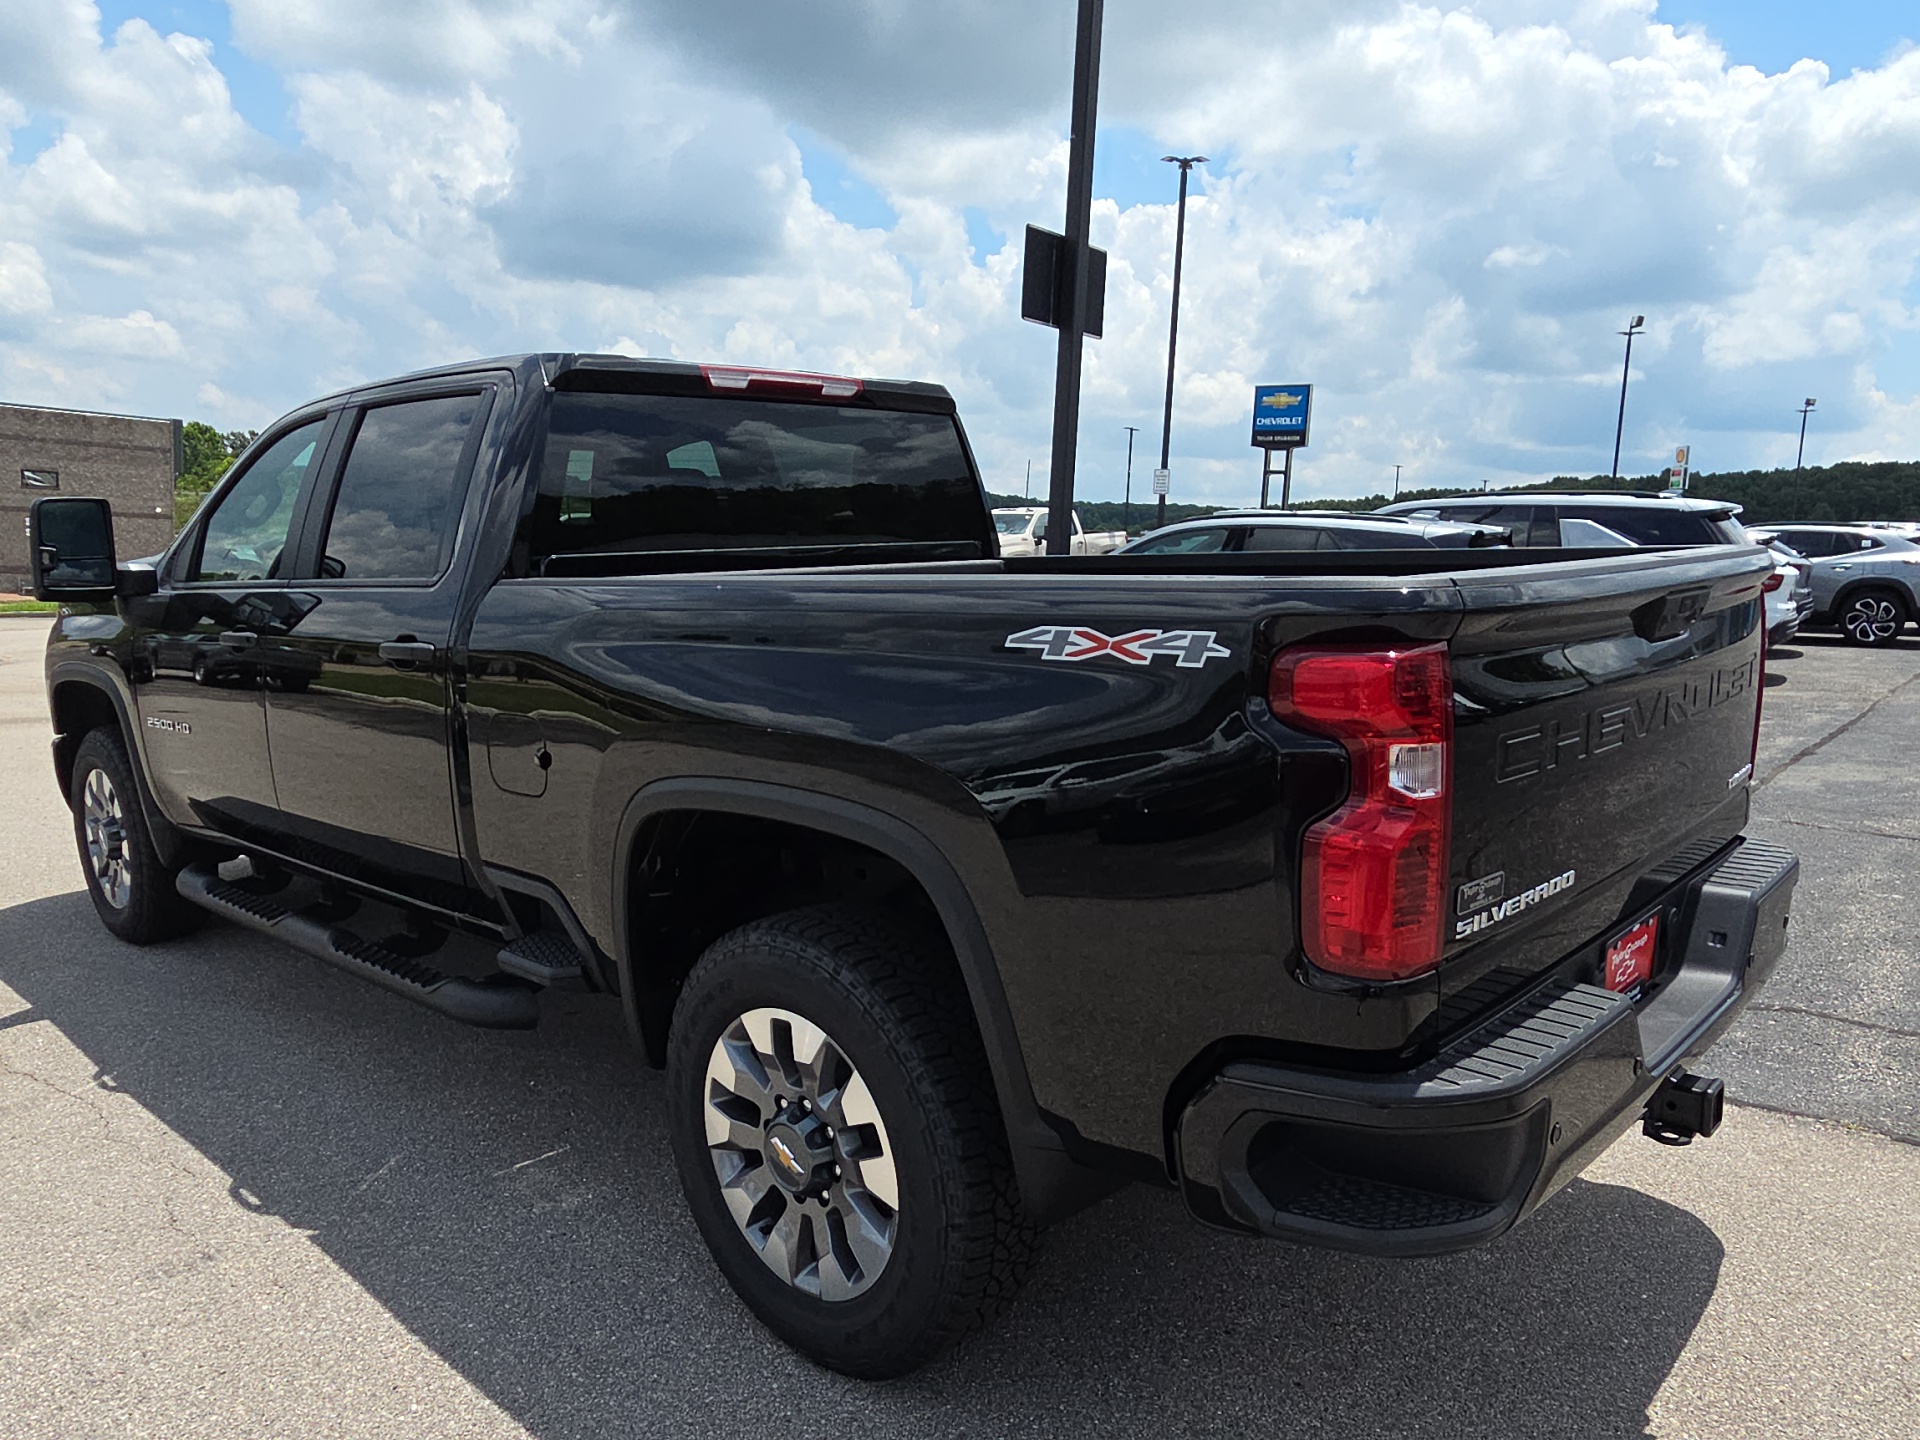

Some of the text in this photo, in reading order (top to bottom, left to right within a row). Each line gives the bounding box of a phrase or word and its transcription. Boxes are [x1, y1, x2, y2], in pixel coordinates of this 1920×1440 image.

[1256, 416, 1303, 426] CHEVROLET
[146, 716, 191, 735] 2500 HD
[1496, 652, 1758, 784] CHEVROLET
[1455, 869, 1576, 940] SILVERADO
